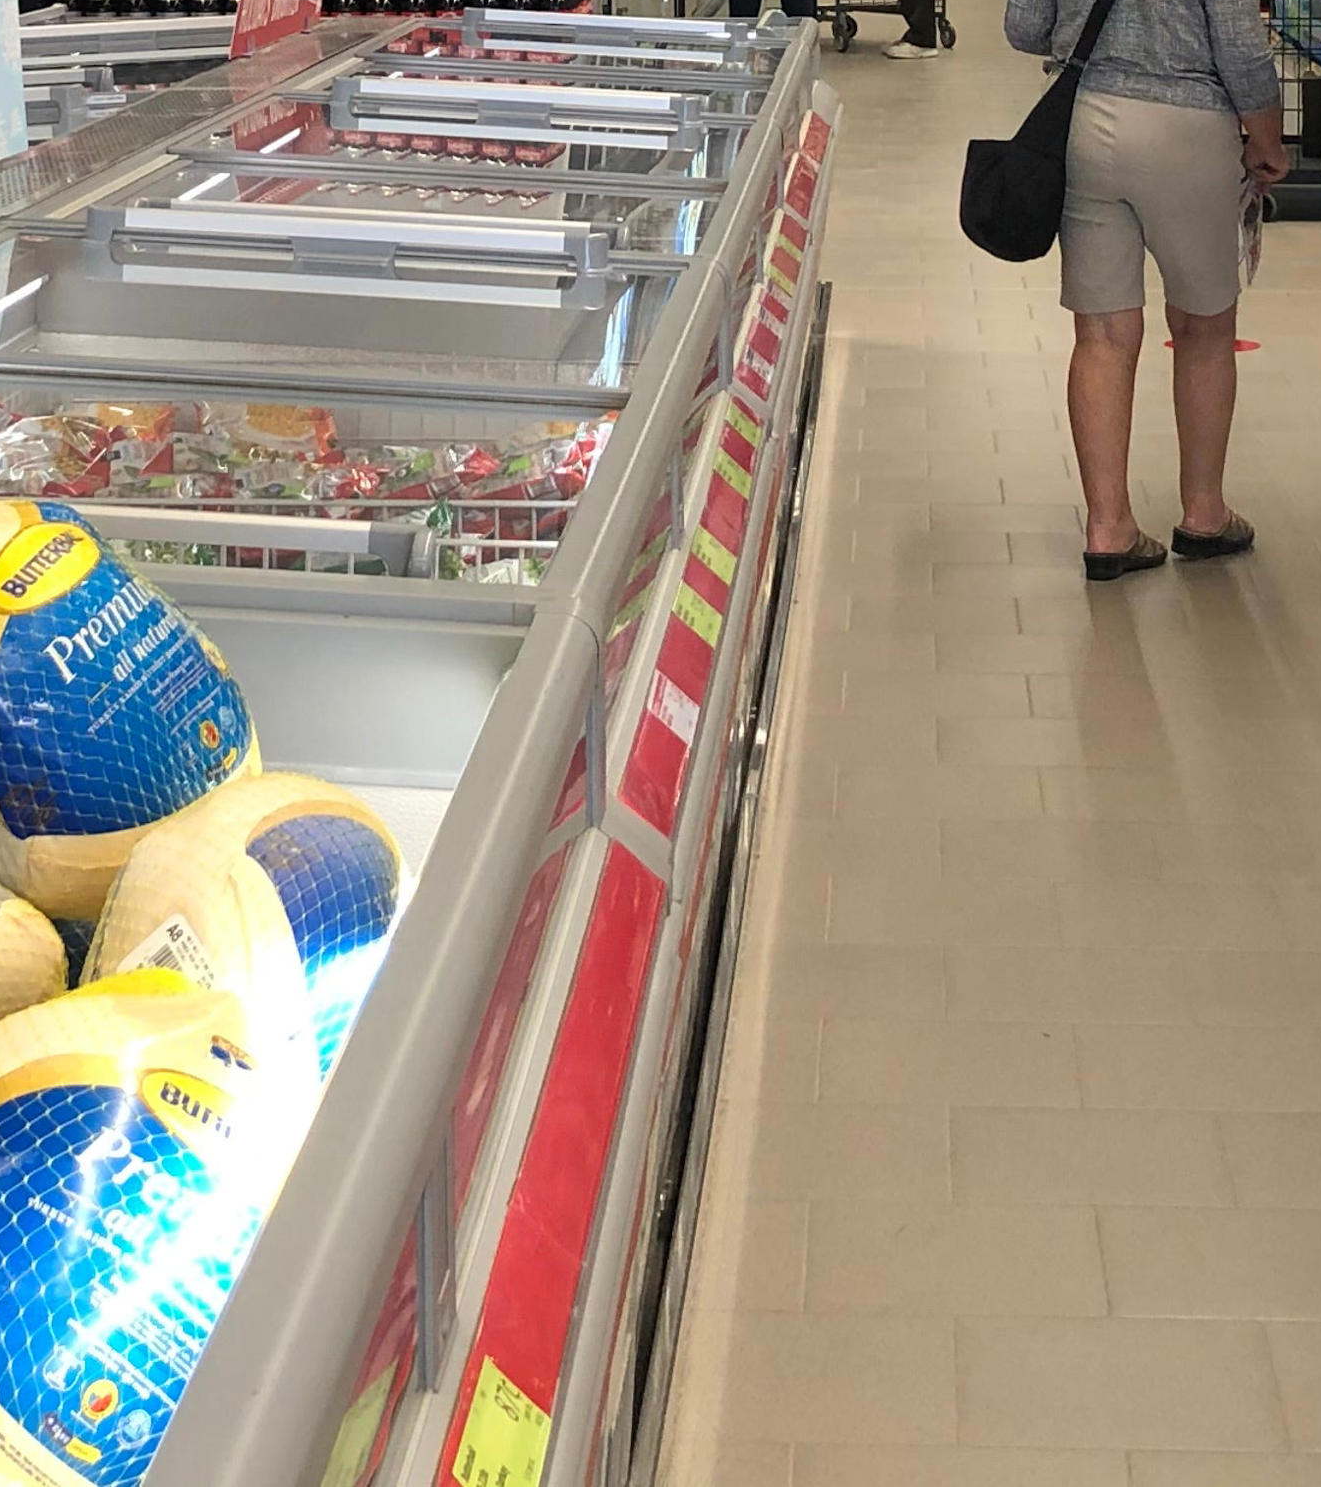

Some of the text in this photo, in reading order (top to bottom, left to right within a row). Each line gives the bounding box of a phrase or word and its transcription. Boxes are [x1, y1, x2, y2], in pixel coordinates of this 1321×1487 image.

[1, 529, 83, 599] BUTTERB
[42, 575, 159, 685] Premiu
[112, 651, 135, 681] all
[164, 921, 186, 942] A8
